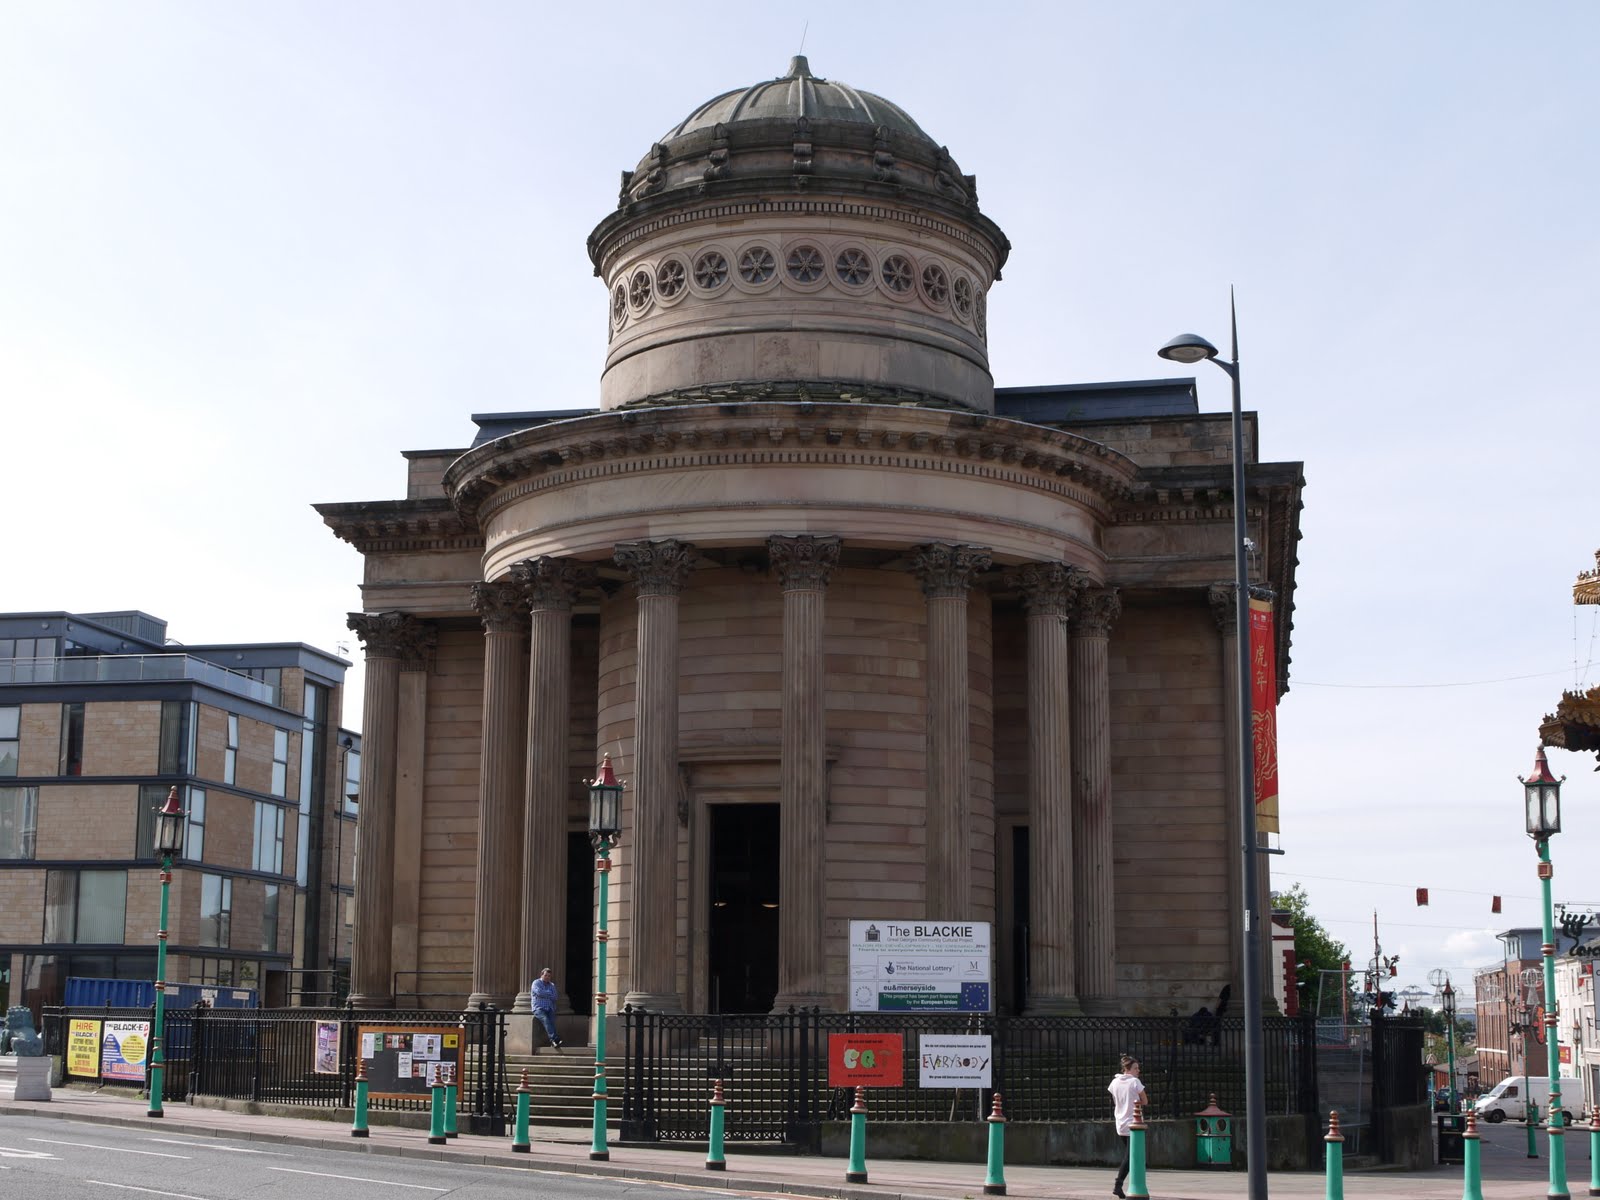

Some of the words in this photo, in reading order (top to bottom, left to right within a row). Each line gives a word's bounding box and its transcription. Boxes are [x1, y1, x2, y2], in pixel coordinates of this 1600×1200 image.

[887, 925, 910, 937] The
[914, 926, 973, 938] BLACKIE
[76, 1022, 94, 1030] HIRE
[922, 1053, 989, 1071] EVERYBODY
